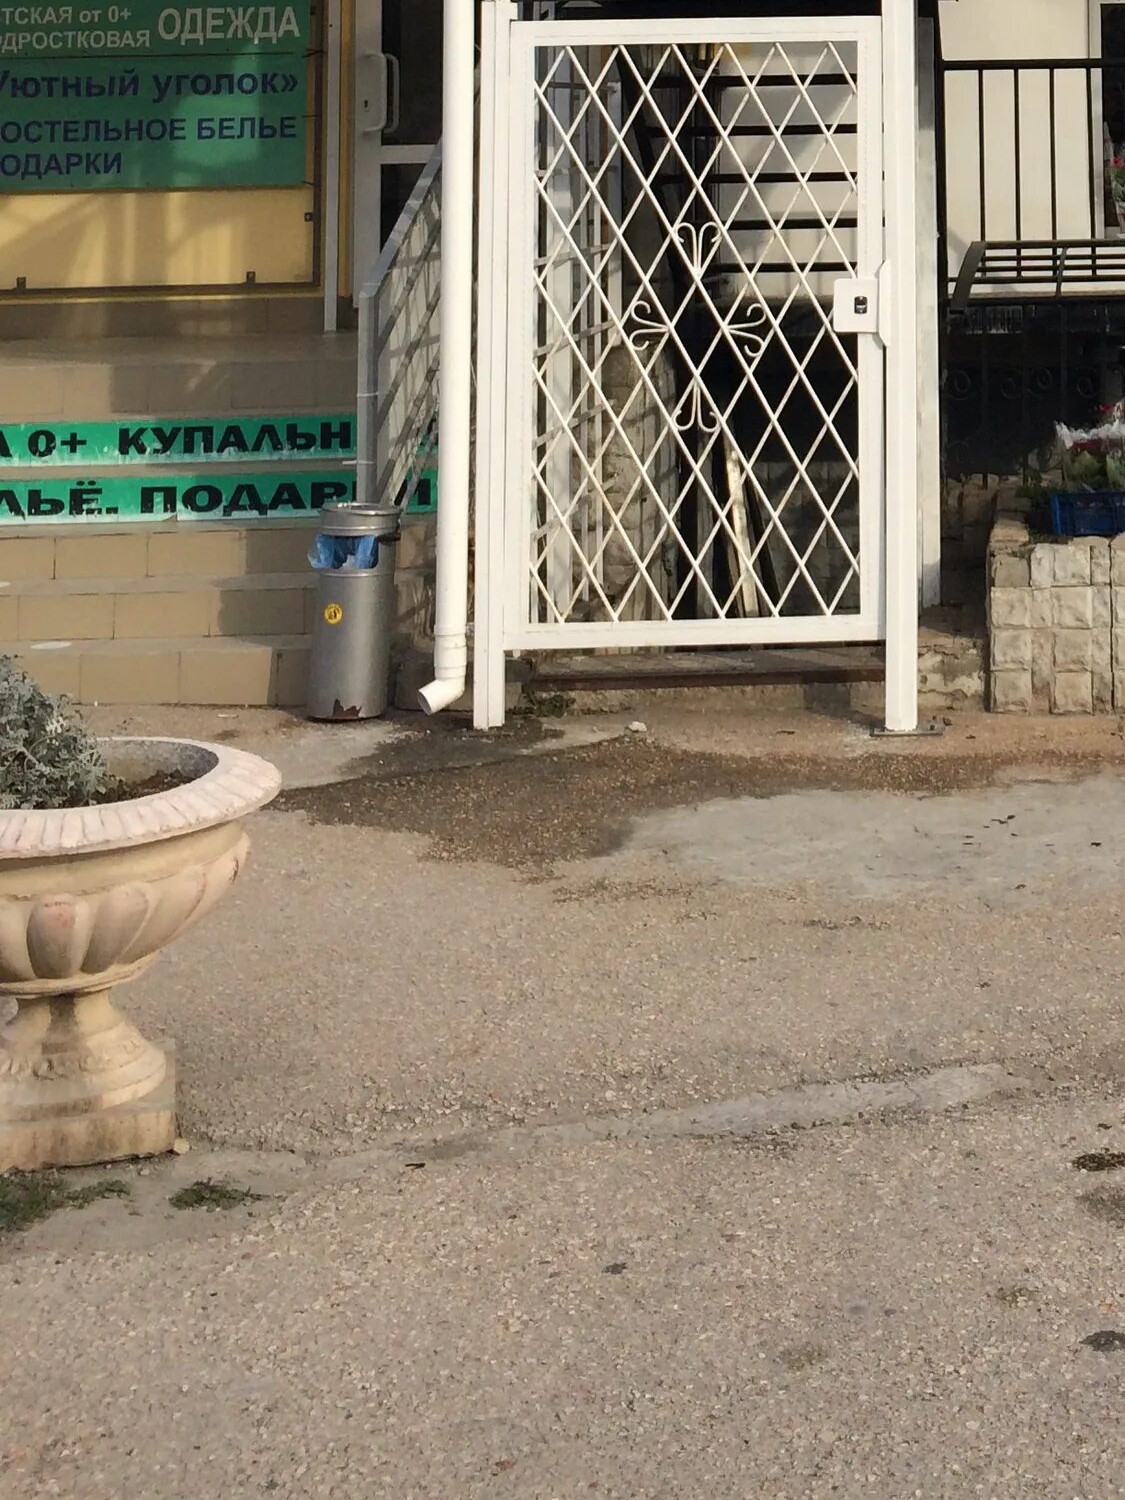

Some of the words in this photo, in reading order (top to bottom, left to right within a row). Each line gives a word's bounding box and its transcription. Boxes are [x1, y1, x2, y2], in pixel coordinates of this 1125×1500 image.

[2, 6, 73, 25] ТСКАЯ
[79, 10, 102, 24] от
[108, 6, 132, 23] 0+
[158, 6, 301, 46] ОДЕЖДА
[0, 30, 150, 52] ДРОСТКОВАЯ
[152, 72, 298, 104] уголок»
[196, 116, 298, 141] БЕЛЬЕ
[0, 152, 122, 180] ОДАРКИ
[141, 476, 432, 516] ПОДАРИ
